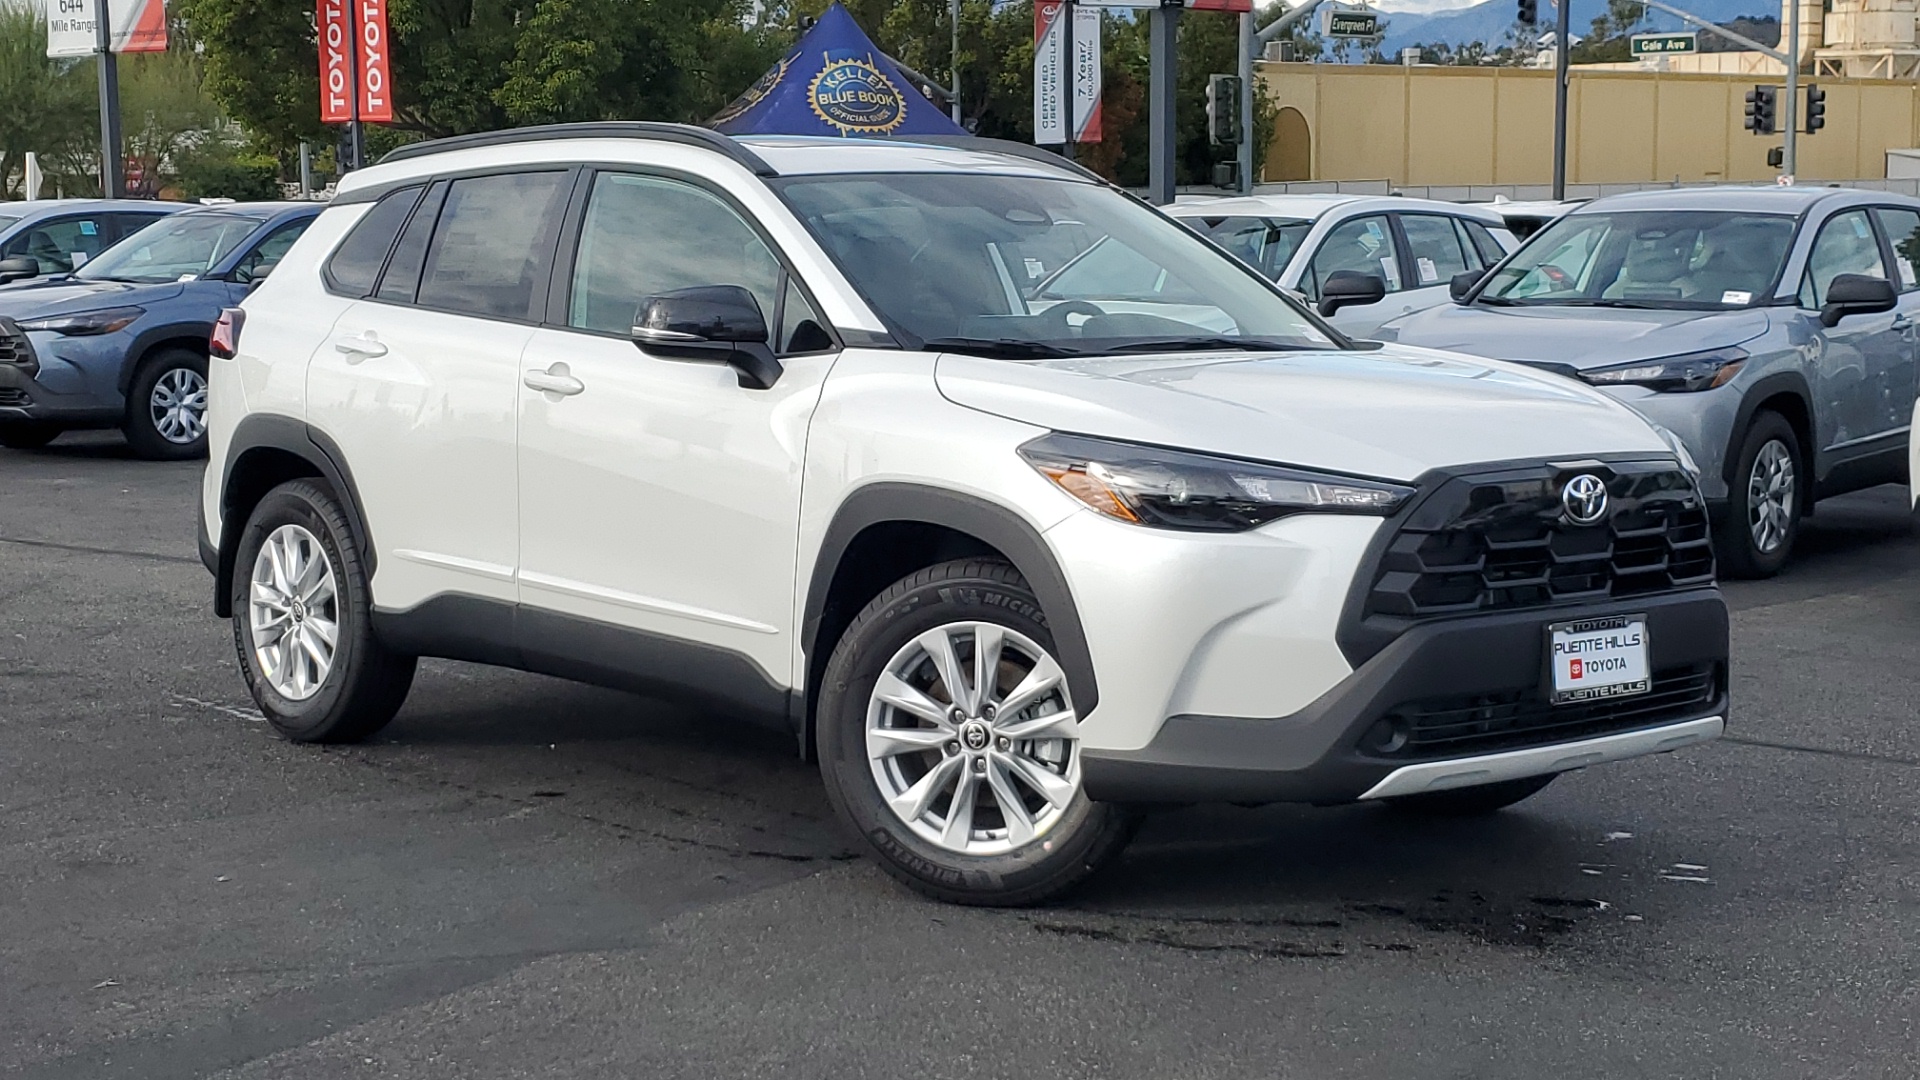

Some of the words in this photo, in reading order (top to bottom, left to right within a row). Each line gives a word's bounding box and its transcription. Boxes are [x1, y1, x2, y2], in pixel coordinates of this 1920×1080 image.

[60, 0, 83, 13] 644
[51, 20, 69, 33] Mile
[71, 19, 99, 33] Range
[1332, 18, 1365, 34] Evergreen
[1366, 19, 1374, 32] Pl
[1641, 40, 1662, 51] Gale
[1666, 39, 1686, 50] Ave
[326, 0, 345, 113] TOYOT
[363, 0, 383, 113] TOYOT
[1049, 30, 1057, 92] VEHICLES
[1077, 40, 1087, 83] Year/
[823, 67, 888, 91] KELLEY
[818, 90, 857, 105] BLUE
[857, 90, 896, 107] BOOK
[1041, 64, 1049, 129] CERTIFIED
[1077, 88, 1087, 98] 7
[830, 106, 870, 122] OFFICIAL
[1049, 95, 1057, 129] USED
[1575, 618, 1624, 631] TOYOTA
[1554, 637, 1604, 655] PUENTE
[1605, 633, 1641, 650] HILLS
[1585, 657, 1627, 674] TOYOTA
[1560, 686, 1609, 702] PUENTE
[1610, 681, 1646, 695] HILLS
